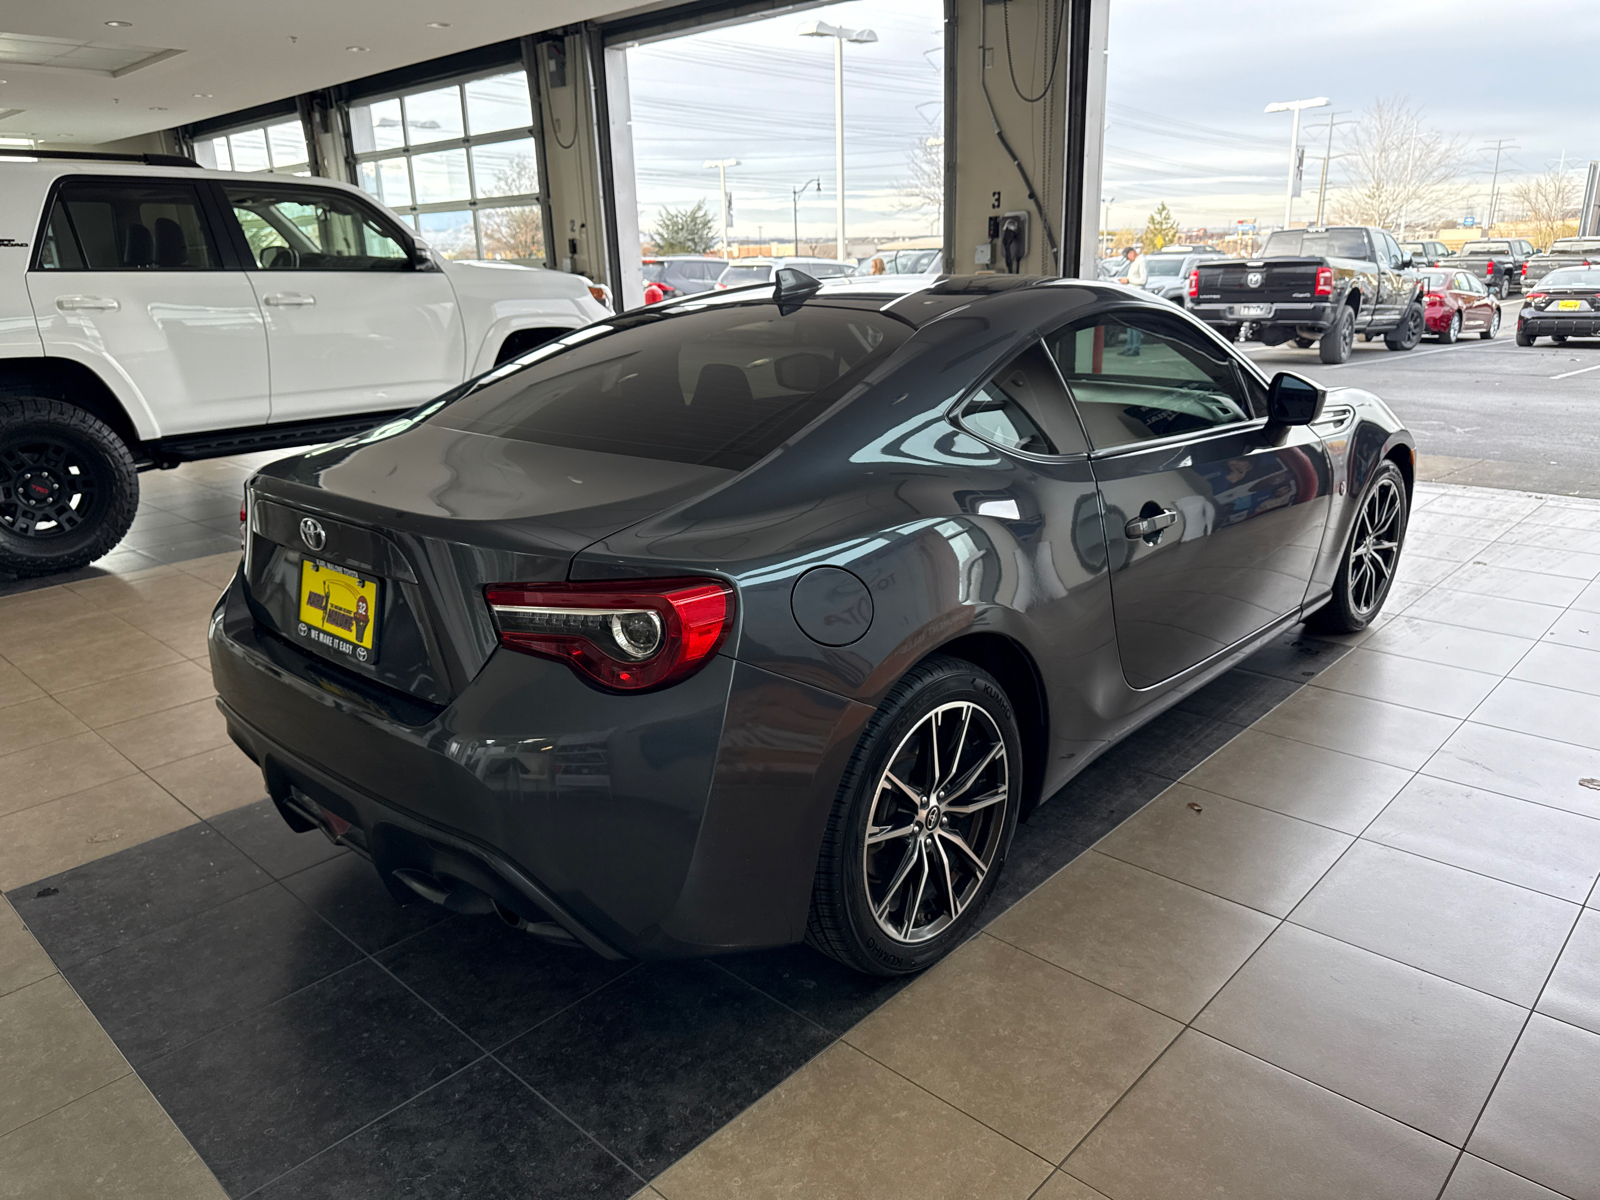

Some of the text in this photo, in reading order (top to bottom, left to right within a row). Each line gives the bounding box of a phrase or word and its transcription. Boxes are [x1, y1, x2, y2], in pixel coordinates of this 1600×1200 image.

[992, 191, 1001, 209] 3
[569, 219, 576, 232] 2
[326, 608, 353, 632] MALONE
[358, 601, 367, 615] 32
[310, 629, 353, 655] WE MAKE IT EASY
[983, 683, 1012, 720] KUMHO
[866, 937, 903, 966] KUMHO
